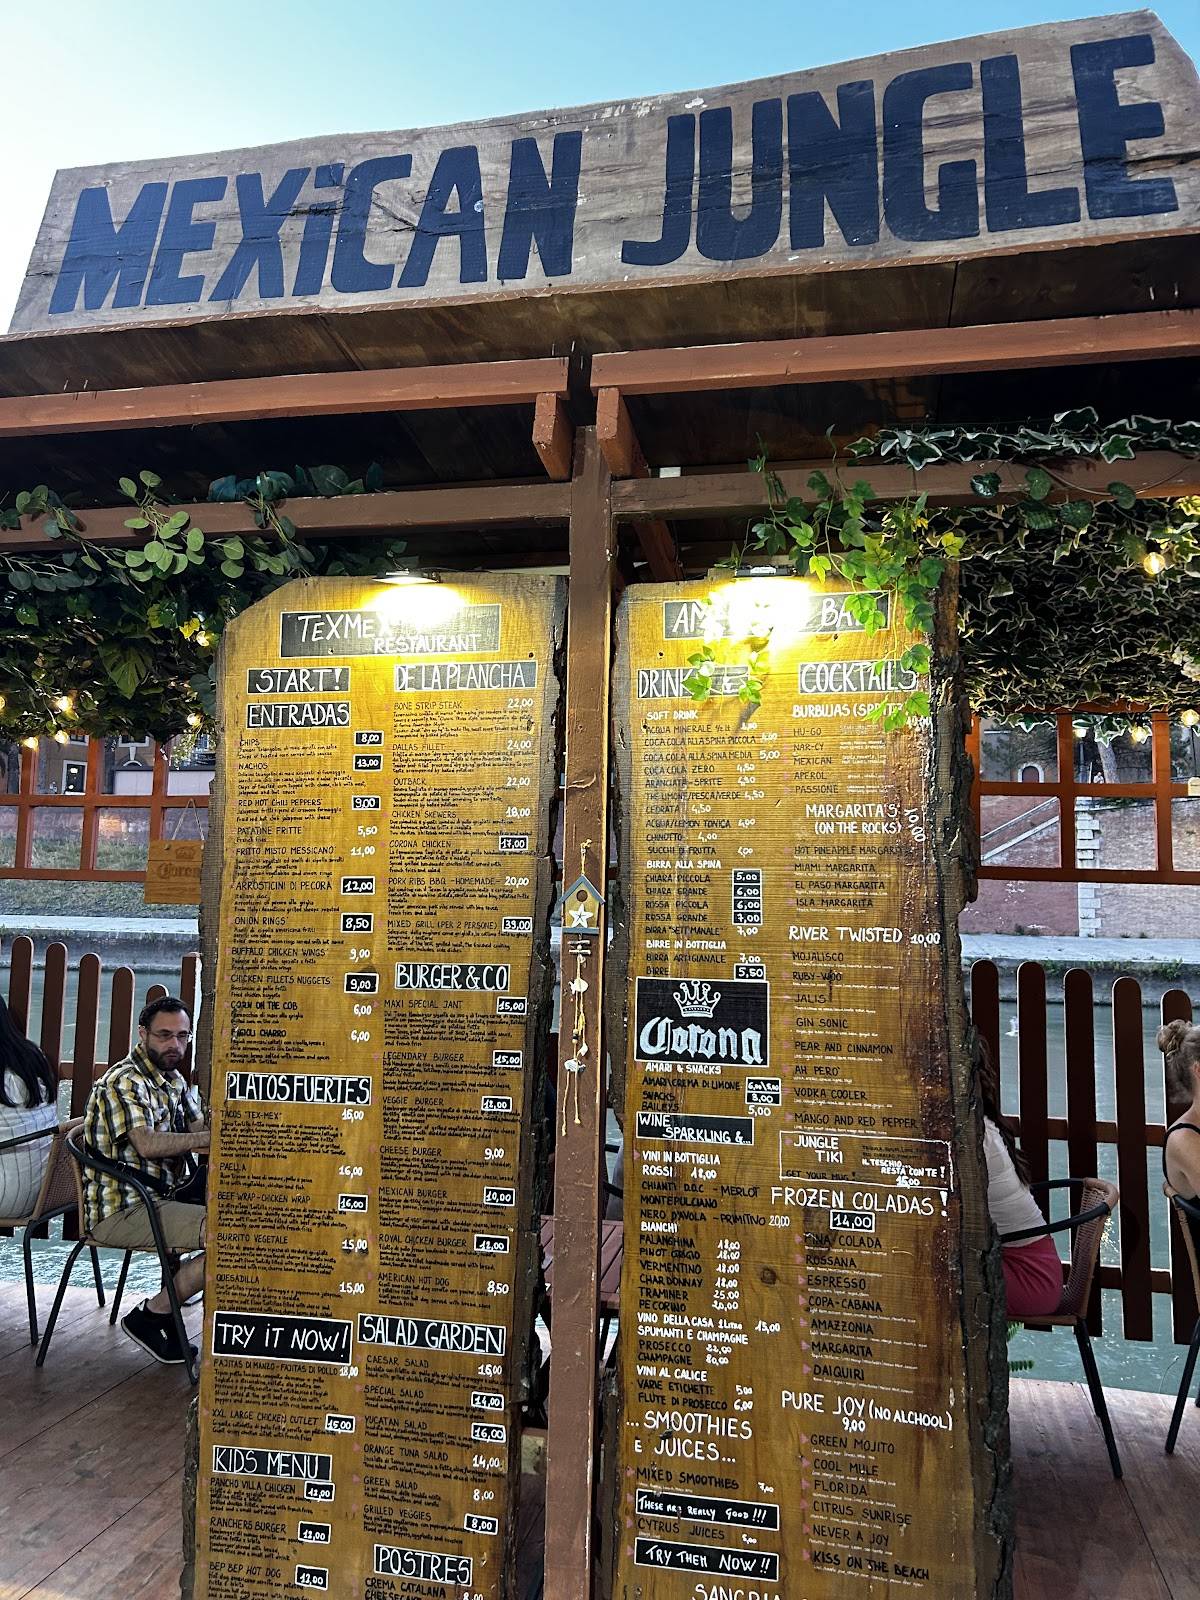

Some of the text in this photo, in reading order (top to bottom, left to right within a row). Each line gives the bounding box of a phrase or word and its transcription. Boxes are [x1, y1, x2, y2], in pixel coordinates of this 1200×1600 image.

[621, 33, 1180, 267] JUNGLE
[374, 634, 481, 654] RESTAURANT
[447, 663, 525, 688] PLANCHA
[249, 704, 349, 727] ENTRADAS
[836, 822, 858, 833] THE
[389, 840, 417, 848] CORONA
[826, 864, 875, 872] MARGARITA
[737, 887, 759, 896] 6,00
[737, 901, 759, 910] 6,00
[345, 919, 369, 930] 8,50
[789, 926, 828, 940] RIVER
[835, 927, 903, 943] TWISTED
[738, 968, 763, 977] 5,50
[796, 1019, 848, 1028] GIN SONIC
[639, 1017, 763, 1064] Corona
[795, 1042, 820, 1051] PEAR
[848, 1044, 893, 1054] CINNAMON
[434, 1054, 464, 1062] BURGER
[229, 1074, 290, 1101] PLATOS
[294, 1076, 369, 1104] FUERTES
[794, 1088, 867, 1100] VODKA COOLER
[639, 1115, 671, 1127] WINE
[794, 1114, 918, 1128] MANGO AND RED PEPPER
[663, 1127, 731, 1143] SPARKLING
[794, 1135, 839, 1149] JUNGLE
[380, 1146, 408, 1154] CHEESE
[413, 1148, 441, 1156] BURGER
[815, 1150, 842, 1163] TIKI
[220, 1163, 246, 1171] PAELLA
[379, 1187, 511, 1203] MEXICAN BURGER 10,00
[771, 1187, 934, 1215] FROZEN COLADAS
[834, 1214, 871, 1229] 14,00
[379, 1234, 400, 1242] ROYAL
[437, 1238, 467, 1246] BURGER
[839, 1234, 882, 1248] COLADA
[806, 1255, 857, 1268] ROSSANA
[216, 1275, 259, 1283] QUESADILLA
[378, 1273, 415, 1283] AMERICAN
[435, 1277, 449, 1286] DOG
[487, 1280, 509, 1296] 8,50
[807, 1275, 866, 1290] ESPRESSO
[811, 1319, 874, 1335] AMAZZONIA
[218, 1323, 255, 1348] TRY
[291, 1326, 348, 1358] NOW!
[363, 1316, 502, 1354] SALAD GARDEN
[637, 1326, 748, 1344] SPUMANTI E CHAMPAGNE
[639, 1340, 692, 1352] PROSECCO
[812, 1341, 873, 1357] MARGARITA
[637, 1365, 708, 1382] VINI AL CALICE
[364, 1385, 396, 1397] SPECIAL
[399, 1391, 424, 1399] SALAD
[782, 1390, 952, 1430] PURE JOY (NO ALCHOOL)
[404, 1420, 427, 1430] SALAD
[811, 1434, 895, 1454] GREEN MOJITO
[364, 1445, 394, 1455] ORANGE
[400, 1447, 419, 1458] TUNA
[424, 1450, 448, 1460] SALAD
[216, 1448, 318, 1479] KIDS MENU
[814, 1459, 841, 1472] COOL
[364, 1477, 390, 1487] GREEN
[395, 1479, 417, 1490] SALAD
[636, 1467, 739, 1489] MIXED SMOOTHIES
[364, 1506, 492, 1530] GRILLED VEGGIES 8,00
[813, 1501, 913, 1525] CITRUS SUNRISE
[638, 1518, 725, 1540] CYTRUS JUICES
[813, 1525, 889, 1547] NEVER A JOY
[380, 1546, 469, 1584] POSTRES
[646, 1545, 671, 1565] TRY
[719, 1555, 756, 1571] NOW
[813, 1550, 840, 1565] KISS
[847, 1556, 863, 1570] ON
[895, 1564, 929, 1580] BEACH
